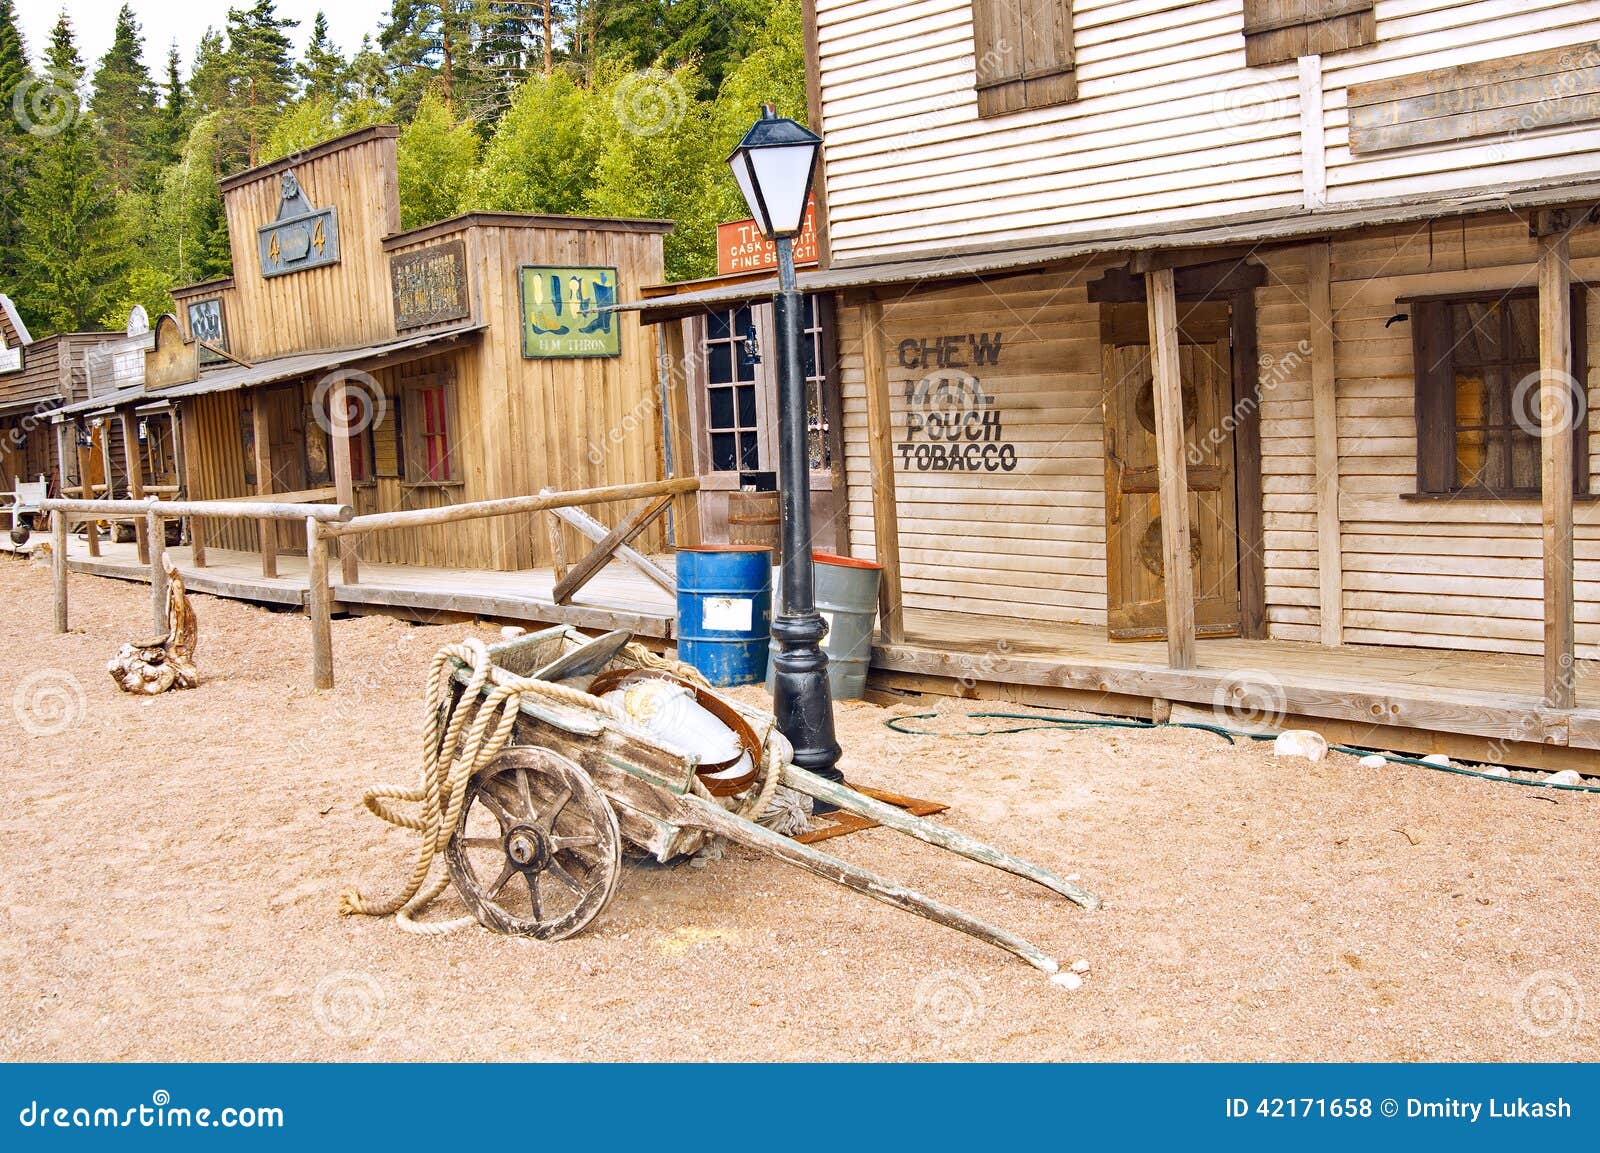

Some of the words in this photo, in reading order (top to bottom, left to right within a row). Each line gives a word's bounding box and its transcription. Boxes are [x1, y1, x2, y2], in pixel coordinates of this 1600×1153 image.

[730, 241, 762, 257] CASK
[731, 254, 760, 270] FINE
[898, 332, 1001, 369] CHEW
[905, 376, 994, 405] MAIL
[907, 410, 1002, 442] POUCH
[898, 443, 1017, 471] TOBACCO
